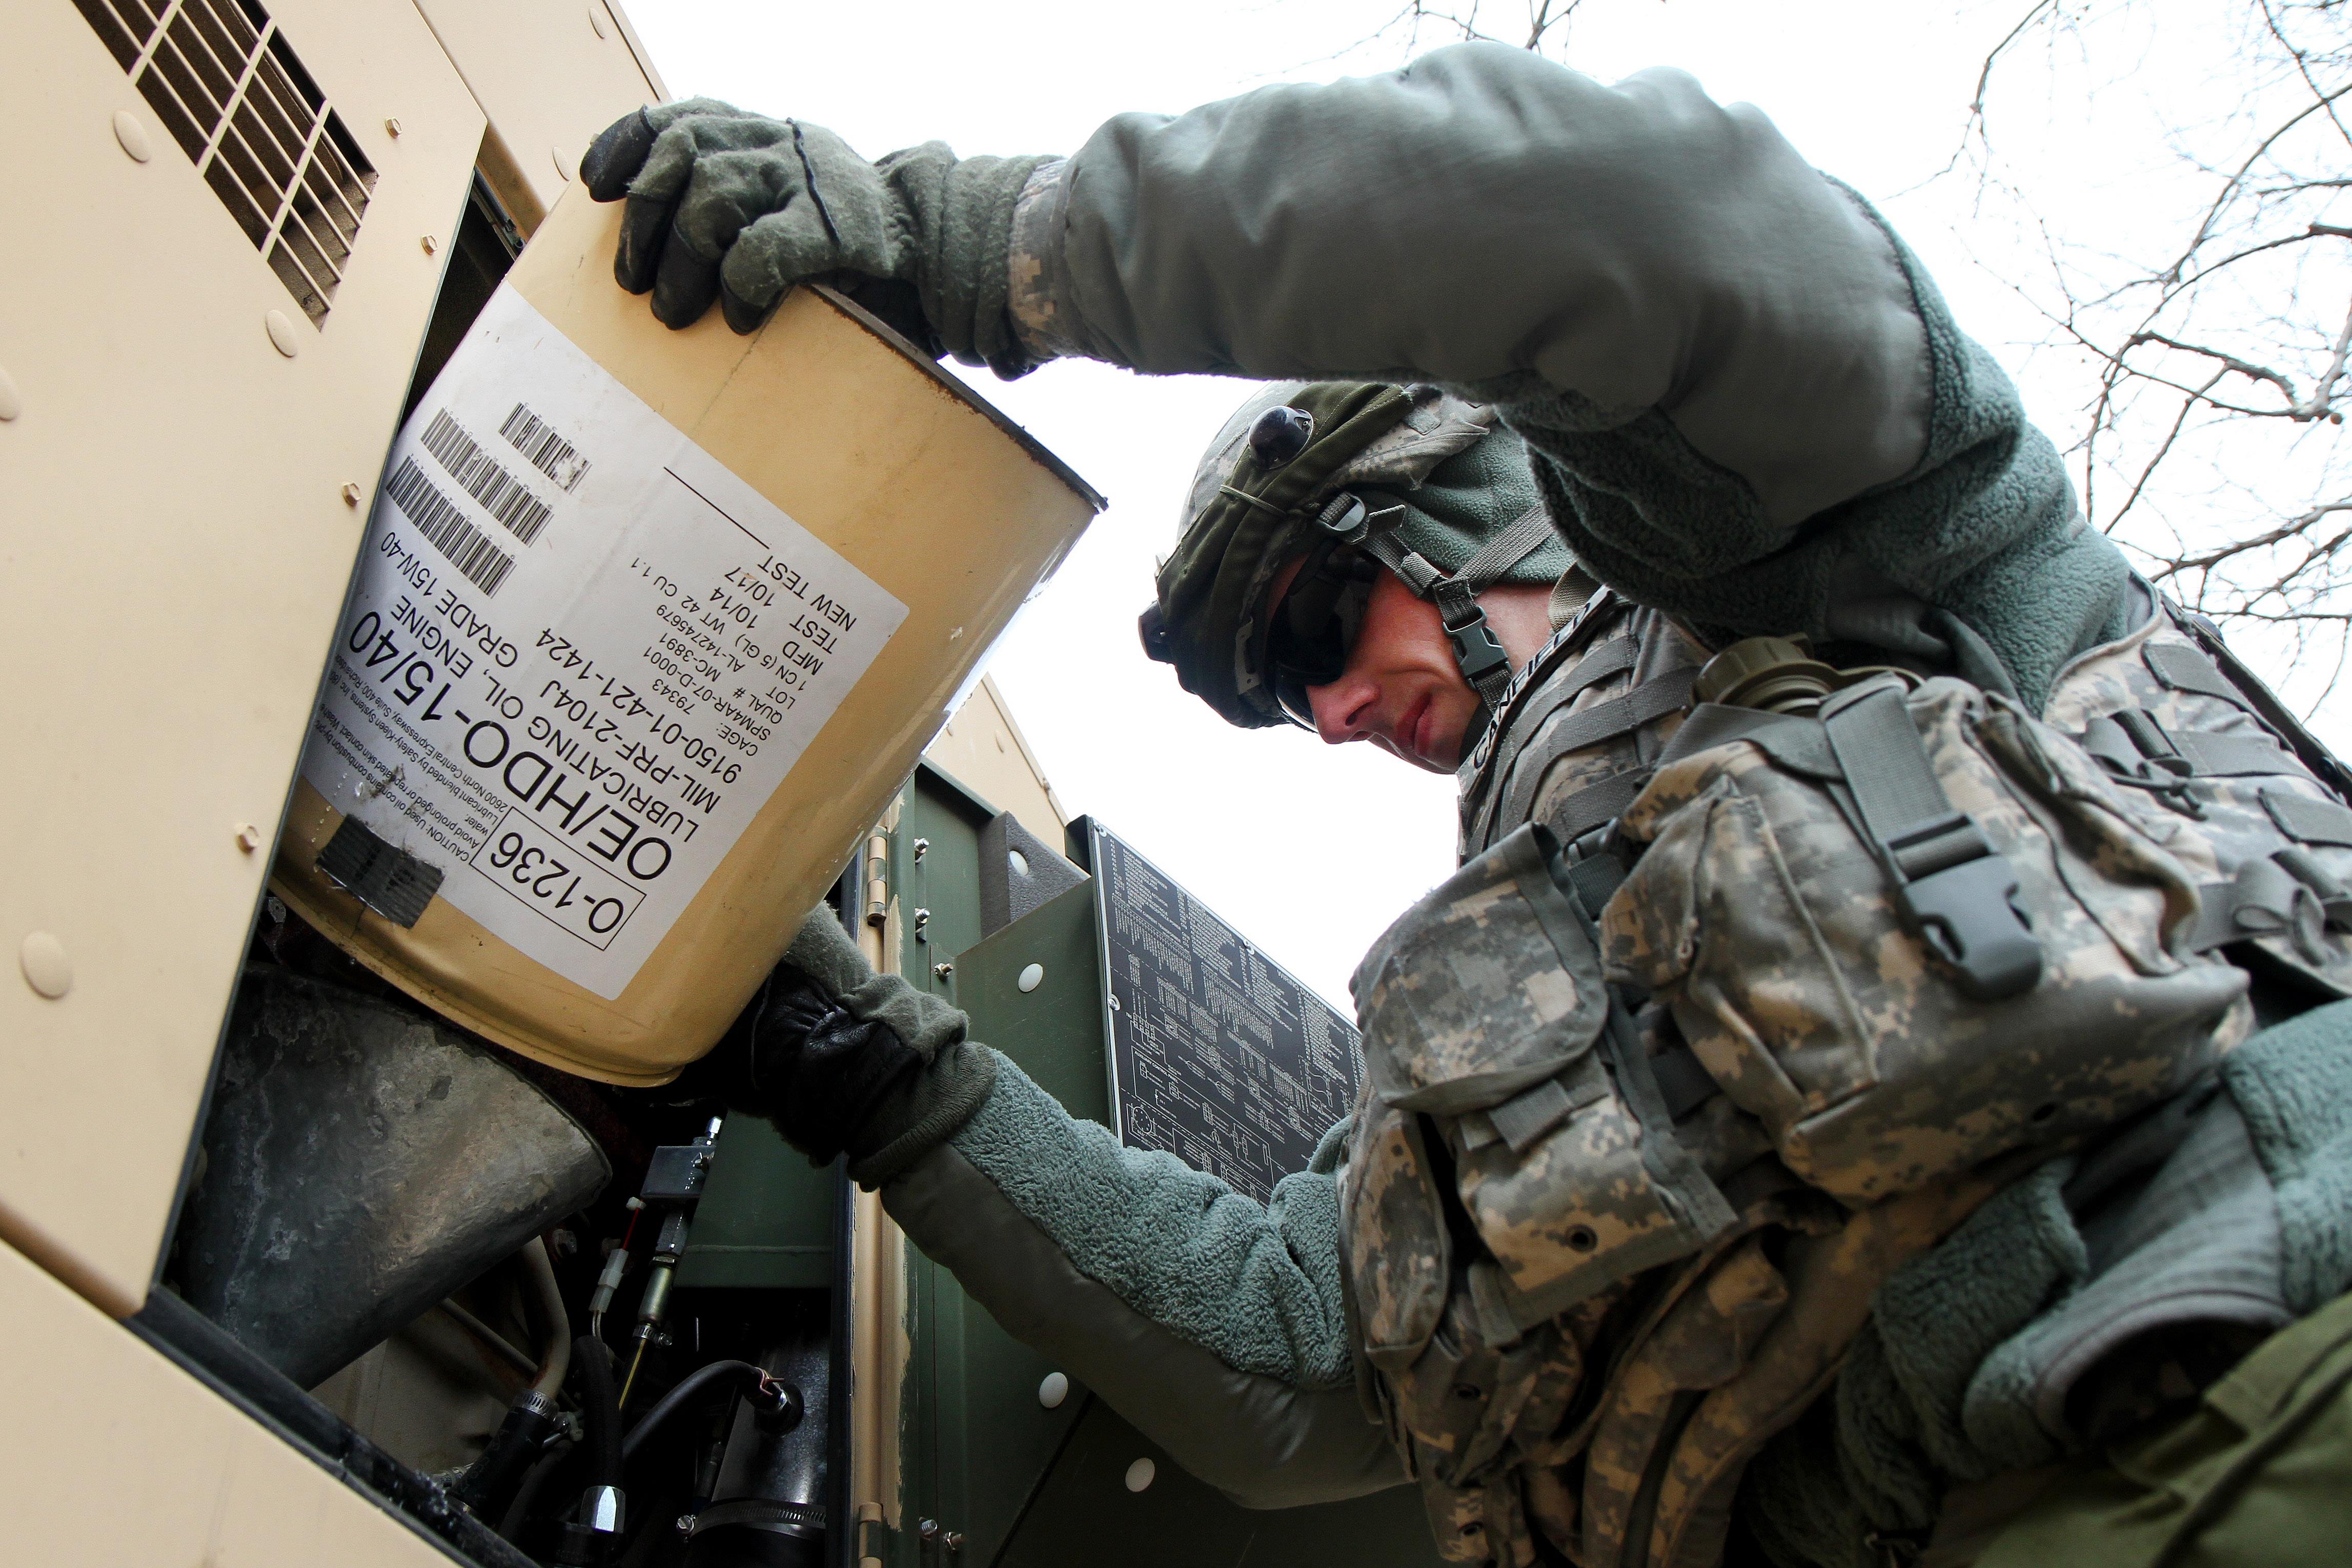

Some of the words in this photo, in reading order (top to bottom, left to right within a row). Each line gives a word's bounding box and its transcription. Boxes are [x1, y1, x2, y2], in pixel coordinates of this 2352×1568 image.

[377, 532, 437, 596] 15W-40
[631, 558, 651, 577] 1.1
[758, 556, 808, 599] TEST
[654, 577, 677, 597] CU
[724, 567, 774, 606] 10/17
[681, 596, 700, 612] 42
[710, 587, 758, 628] 10/14
[810, 595, 857, 632] NEW
[391, 596, 473, 679] ENGINE
[436, 589, 517, 667] GRADE
[657, 605, 745, 672] AL-142745679
[700, 613, 725, 635] WT
[789, 615, 837, 654] TEST
[660, 633, 721, 682] MC-3891
[736, 634, 760, 658] GL)
[760, 655, 777, 669] (5
[783, 641, 823, 675] MFD
[776, 665, 797, 684] CN
[798, 681, 806, 690] 1
[350, 690, 376, 723] Systems,
[375, 697, 391, 717] Suite
[483, 669, 523, 719] OIL,
[536, 628, 741, 783] 9150-01-421-1424
[643, 647, 771, 740] SPM4AR-07-D-0001
[653, 679, 695, 715] 79343
[733, 687, 746, 698] #
[749, 694, 782, 724] QUAL
[766, 687, 795, 709] LOT
[349, 610, 672, 880] OE/HDO-15/40
[375, 719, 418, 762] Safety-Kleen
[392, 711, 435, 756] Expressway,
[540, 681, 721, 813] MIL-PRF-2104J
[717, 723, 758, 756] CAGE:
[331, 739, 367, 776] combustion
[362, 748, 377, 764] skin
[417, 758, 429, 770] by
[432, 751, 462, 778] Central
[366, 773, 396, 802] contains
[406, 790, 416, 799] or
[427, 766, 460, 796] blended
[463, 775, 486, 797] North
[528, 717, 699, 842] LUBRICATING
[394, 800, 405, 810] oil
[403, 807, 426, 829] Used
[414, 797, 458, 830] prolonged
[459, 791, 498, 824] Lubricant
[484, 792, 508, 812] 2600
[454, 828, 479, 848] Avoid
[464, 817, 488, 836] water.
[427, 826, 469, 861] CAUTION:
[491, 832, 623, 933] O-1236
